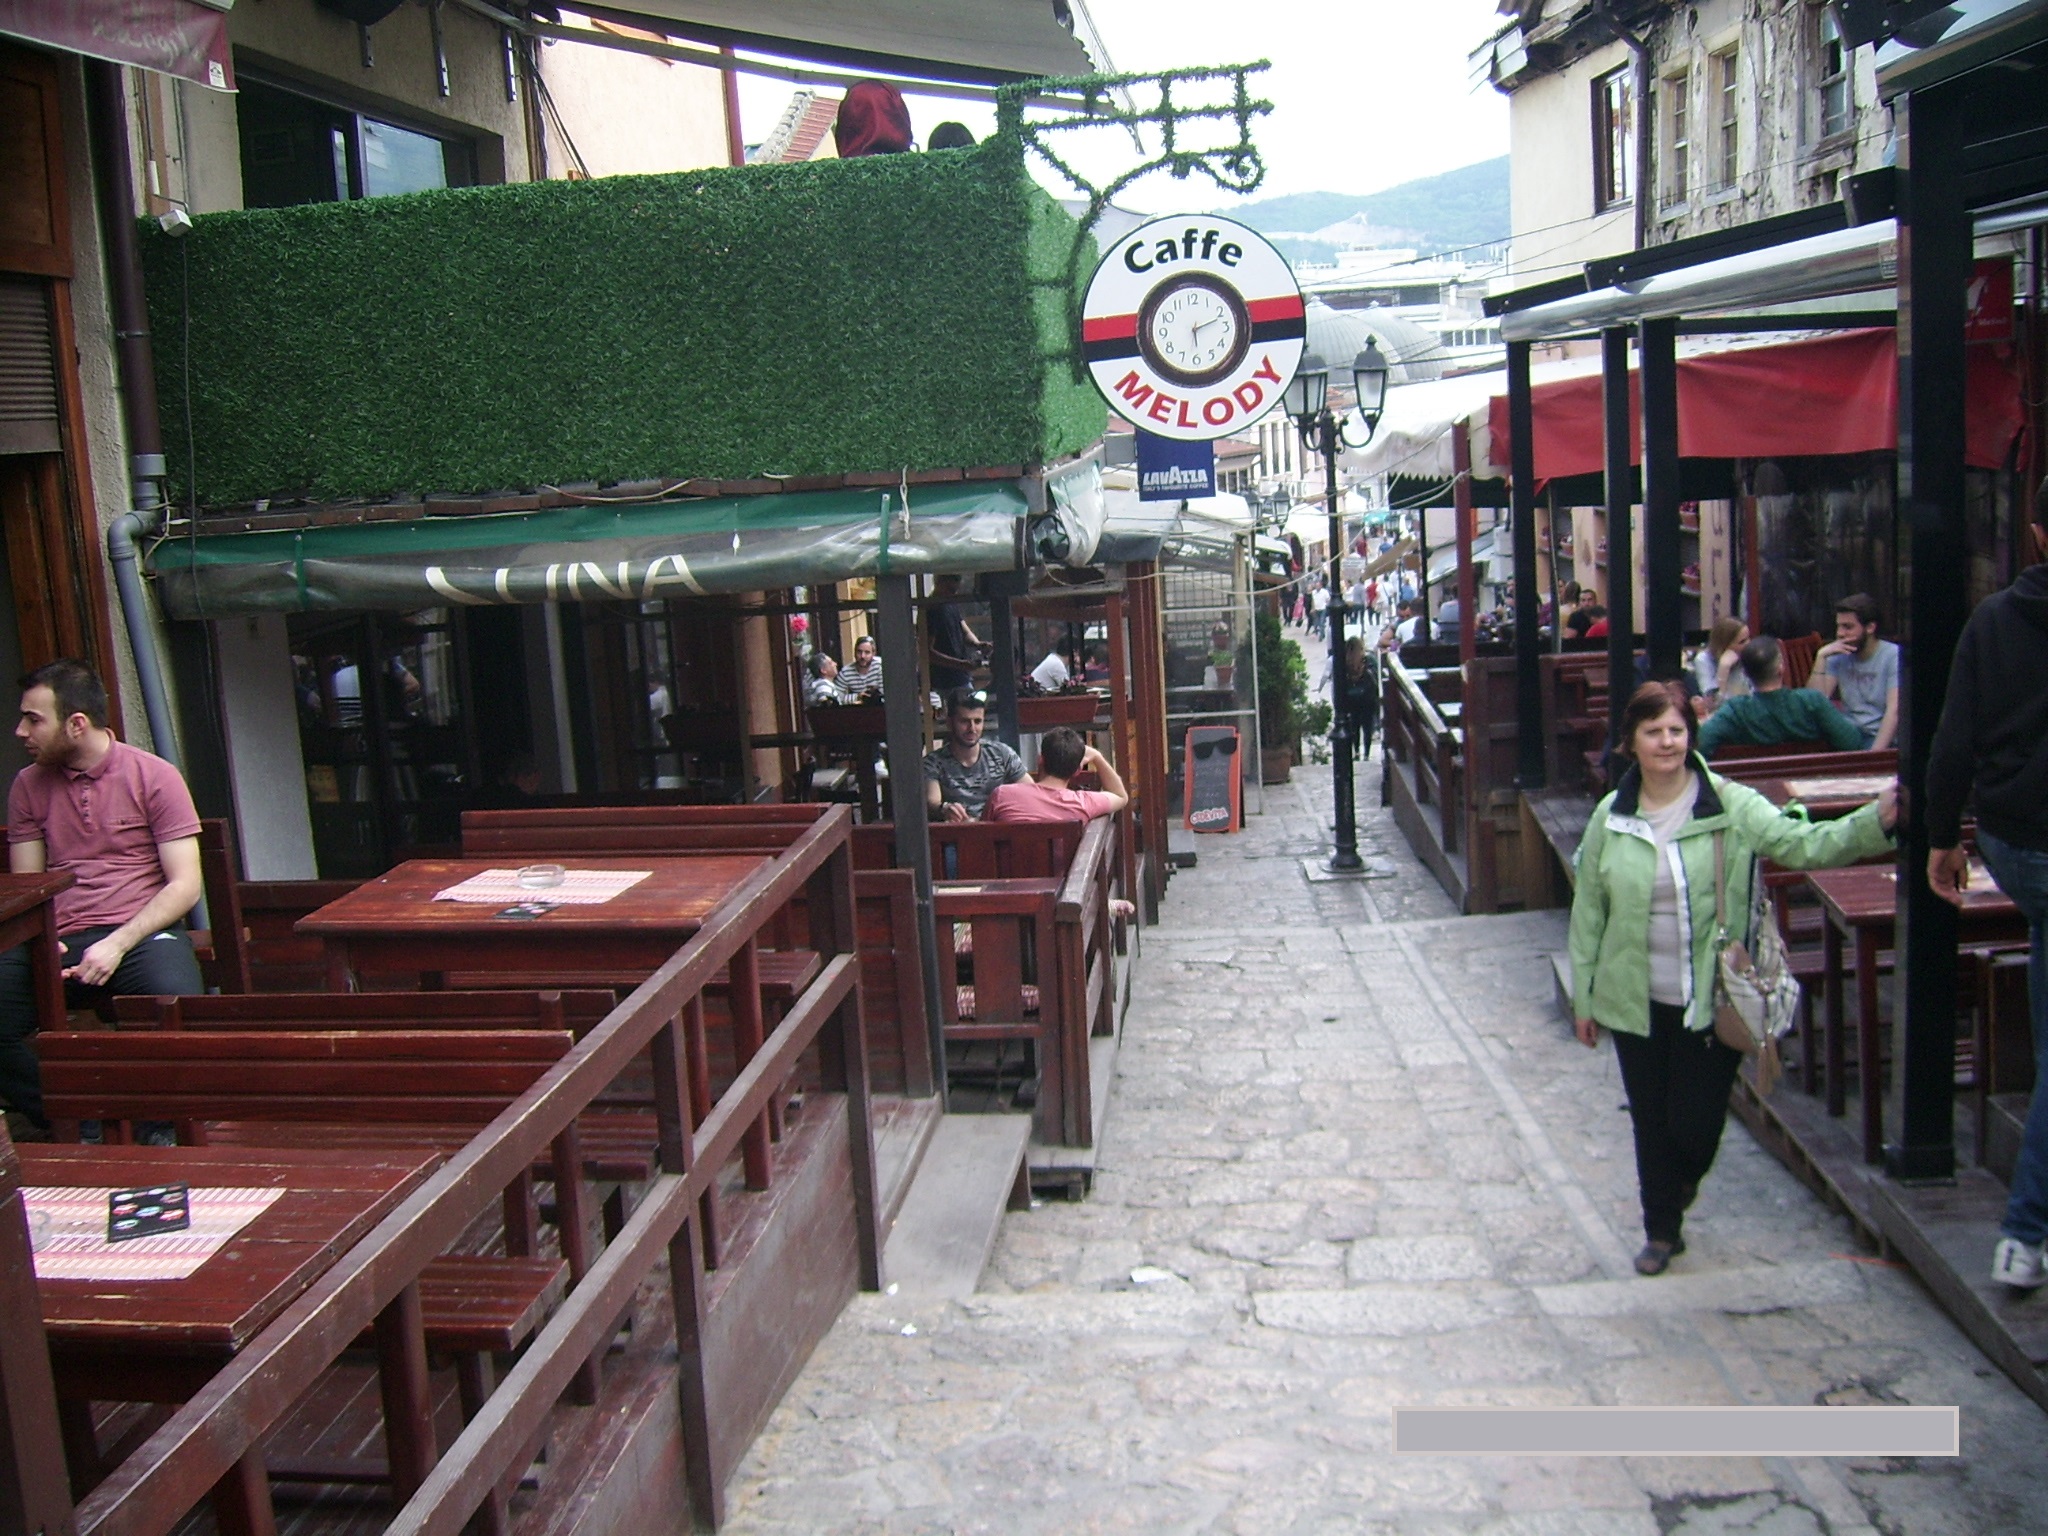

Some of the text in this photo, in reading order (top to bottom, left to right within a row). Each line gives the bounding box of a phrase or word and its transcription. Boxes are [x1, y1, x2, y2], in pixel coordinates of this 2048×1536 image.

[1123, 227, 1243, 274] Caffe
[1173, 299, 1182, 311] 11
[1187, 293, 1199, 306] 12
[1205, 296, 1209, 308] 1
[1162, 311, 1175, 324] 10
[1216, 305, 1224, 318] 2
[1158, 327, 1168, 339] 9
[1222, 320, 1230, 333] 3
[1165, 340, 1174, 354] 8
[1216, 337, 1225, 349] 4
[1178, 351, 1186, 363] 7
[1192, 353, 1201, 366] 6
[1208, 348, 1215, 361] 5
[1113, 355, 1282, 428] MELODY
[1142, 465, 1208, 486] LAVAZZA
